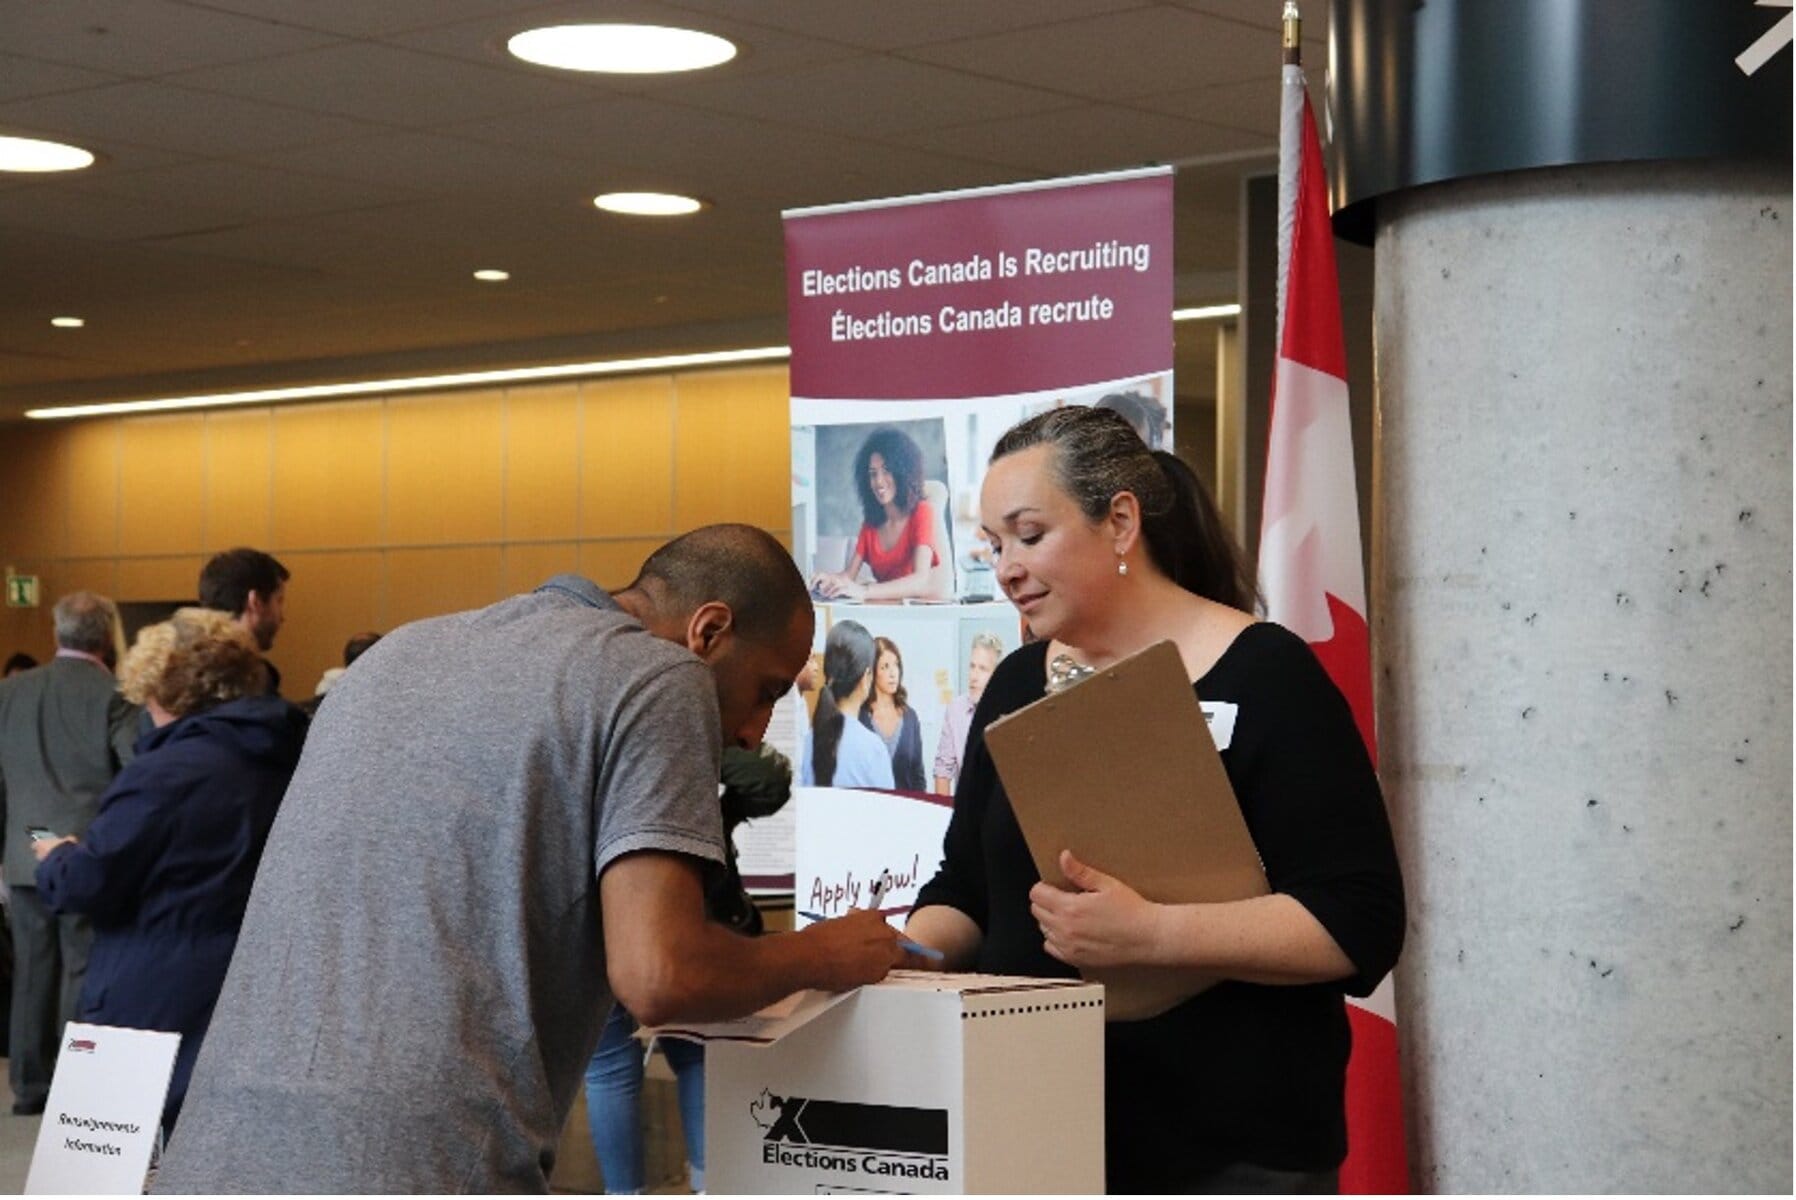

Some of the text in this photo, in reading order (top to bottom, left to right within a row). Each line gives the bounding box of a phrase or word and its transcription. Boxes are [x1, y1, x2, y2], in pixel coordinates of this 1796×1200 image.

[803, 240, 1150, 297] Elections Canada Is Recruiting
[832, 294, 1114, 341] Élections Canada recrute
[810, 871, 861, 914] Apply
[763, 1143, 949, 1180] Elections Canada
